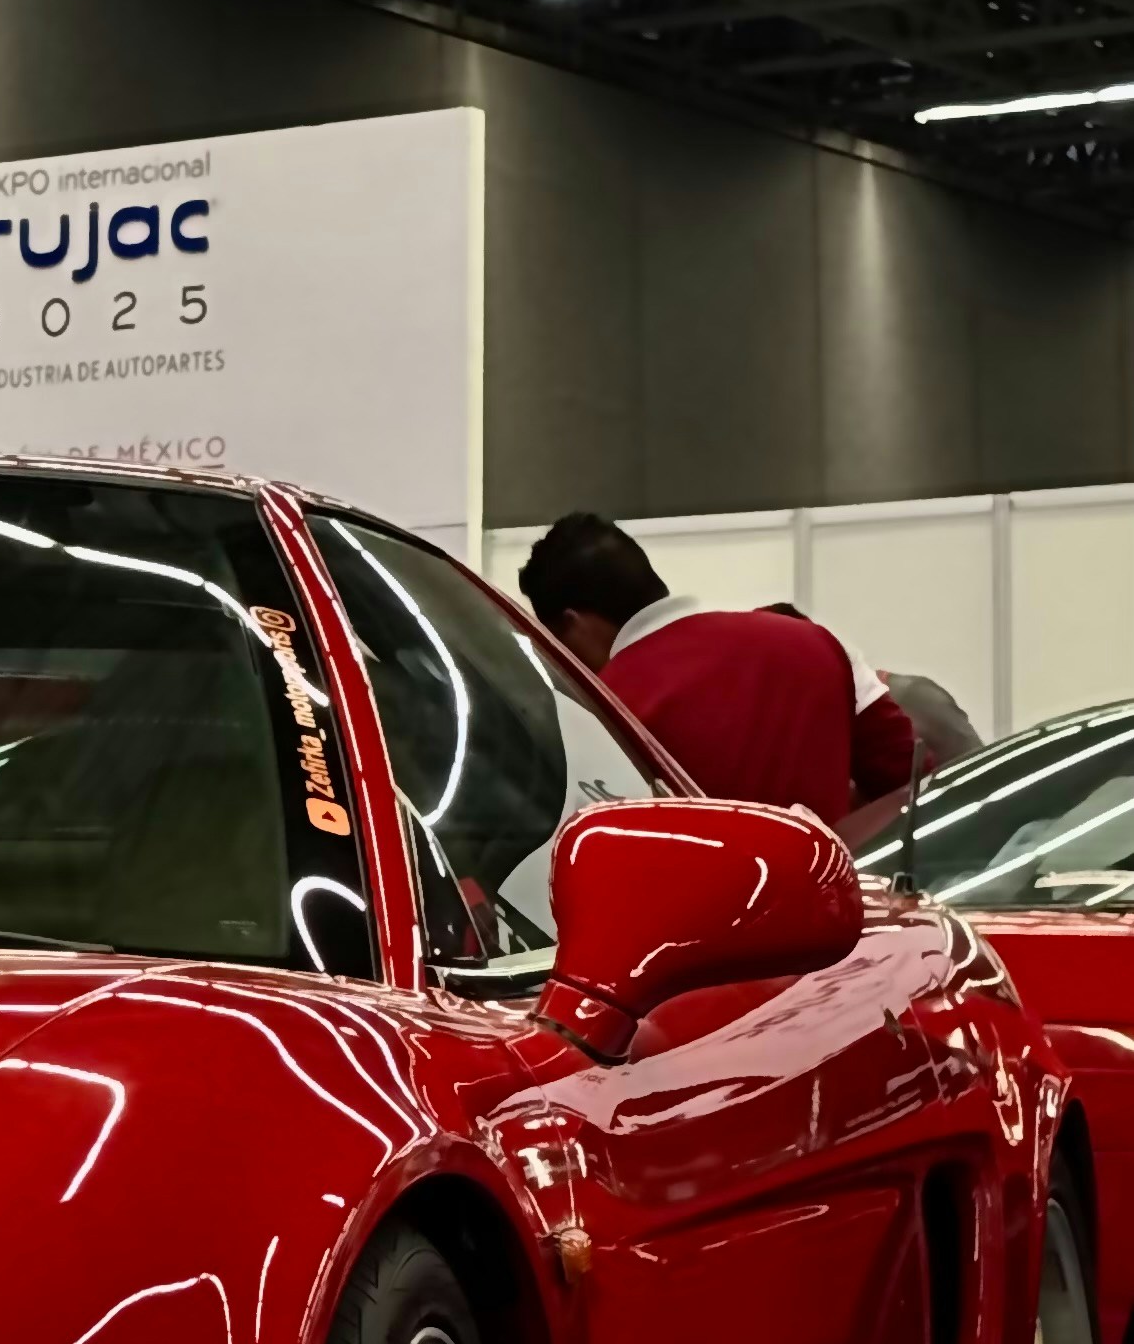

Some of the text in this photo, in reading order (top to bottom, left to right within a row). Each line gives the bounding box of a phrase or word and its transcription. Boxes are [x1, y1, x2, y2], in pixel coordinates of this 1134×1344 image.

[58, 150, 211, 193] internacional
[77, 358, 102, 383] DE
[104, 348, 226, 380] AUTOPARTES
[117, 434, 226, 461] MÉXICO
